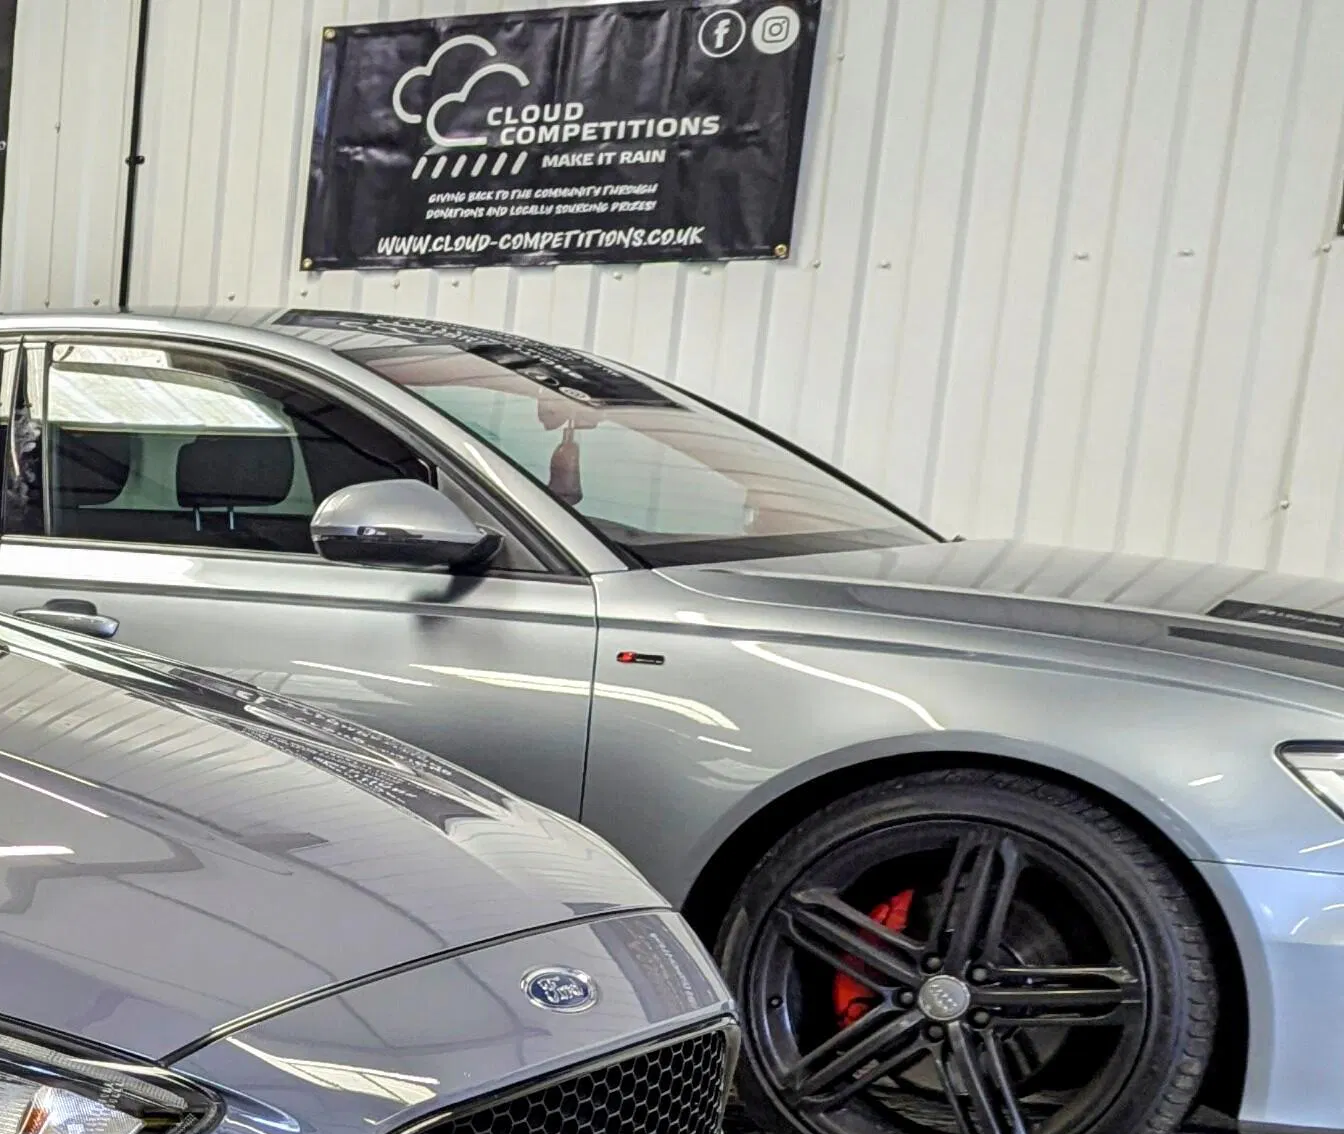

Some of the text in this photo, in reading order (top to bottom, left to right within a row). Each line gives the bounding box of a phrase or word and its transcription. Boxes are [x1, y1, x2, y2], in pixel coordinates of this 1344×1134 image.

[487, 102, 584, 126] CLOUD
[500, 115, 721, 146] COMPETITIONS
[541, 149, 667, 168] MAKE IT RAIN
[428, 183, 659, 204] GIVING BACK TO THE COMMUNITY THROUGH
[425, 206, 485, 219] DONATIONS
[486, 205, 508, 217] AND
[509, 203, 554, 216] LOCALLY
[554, 201, 609, 214] SOURCING
[377, 226, 706, 256] WWW.CLOUD-COMPETITIONS.CO.UK
